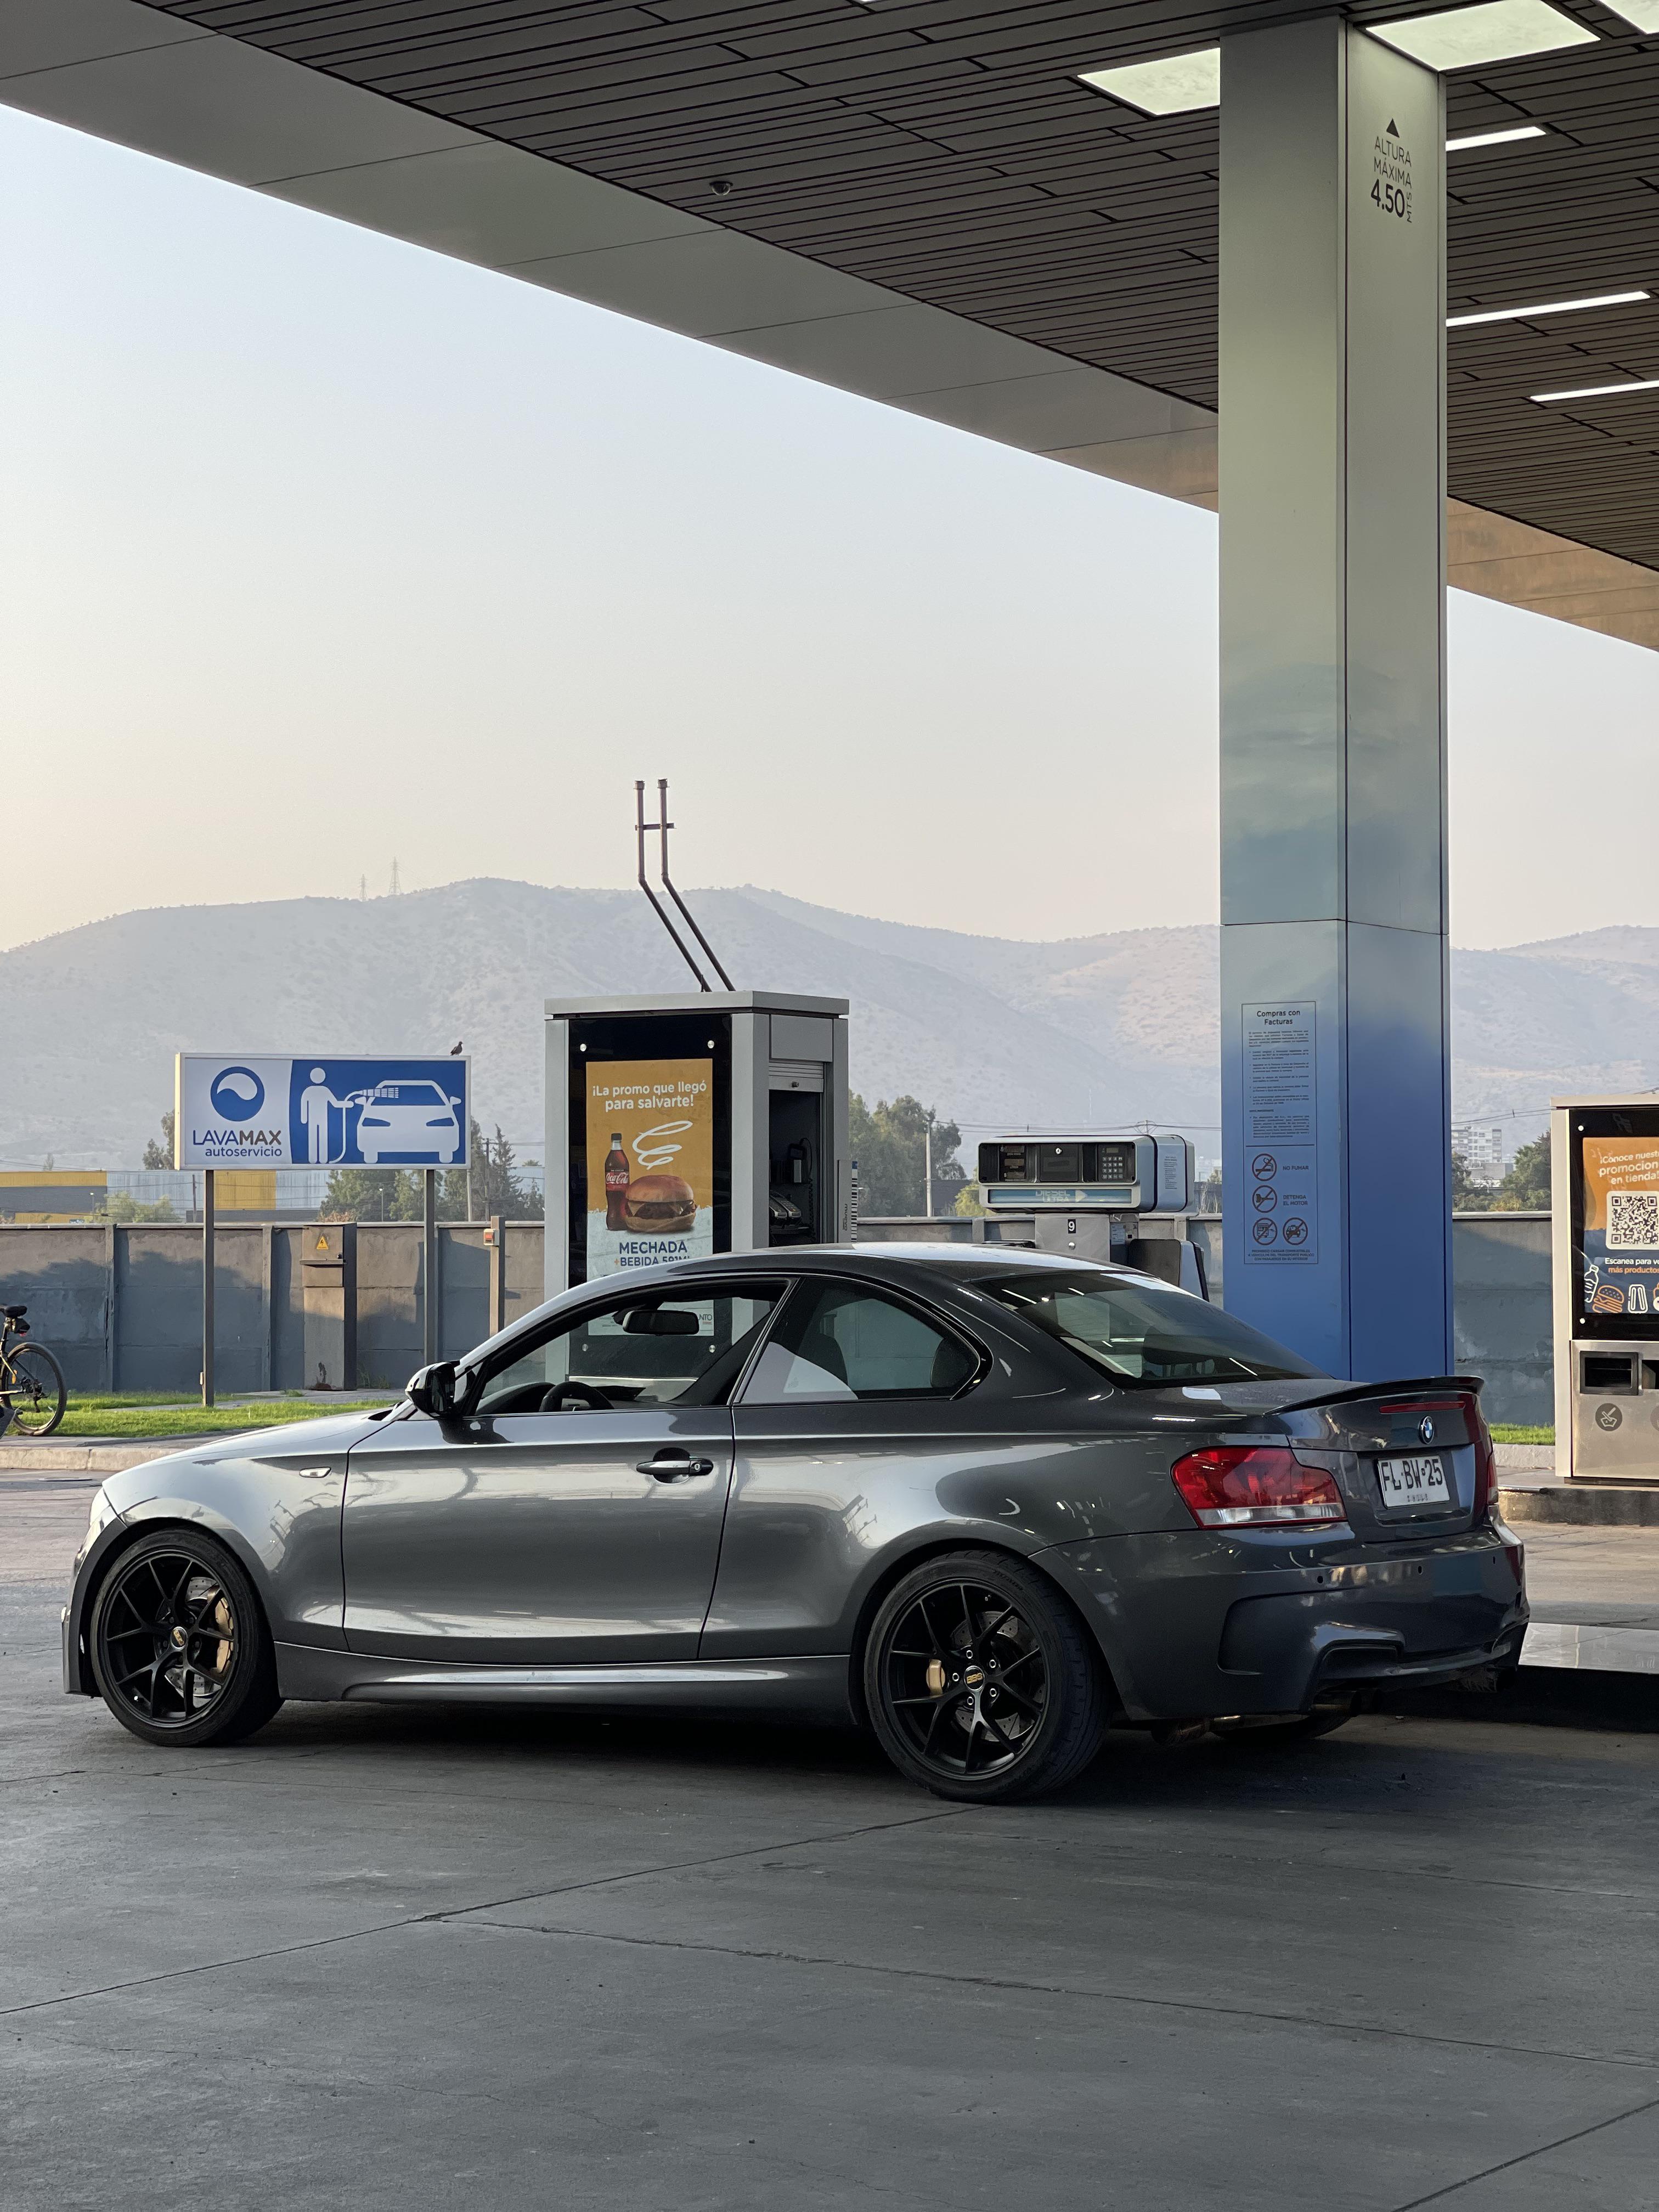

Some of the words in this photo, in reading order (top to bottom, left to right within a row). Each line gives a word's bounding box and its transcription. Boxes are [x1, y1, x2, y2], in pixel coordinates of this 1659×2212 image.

[1374, 136, 1412, 167] ALTURA
[1374, 156, 1412, 189] MÁXIMA
[1371, 178, 1405, 218] 4.50
[592, 1086, 610, 1096] ¡La
[613, 1085, 650, 1097] promo
[653, 1084, 675, 1095] que
[678, 1080, 707, 1094] llegó
[605, 1099, 634, 1113] para
[637, 1094, 694, 1109] salvarte!
[193, 1130, 281, 1146] LAVAMAX
[205, 1146, 282, 1157] autoservicio
[1600, 1154, 1634, 1164] ¡Conoce
[1611, 1177, 1623, 1185] en
[1068, 1221, 1075, 1232] 9
[619, 1240, 687, 1254] MECHADA
[967, 1673, 983, 1684] BBS
